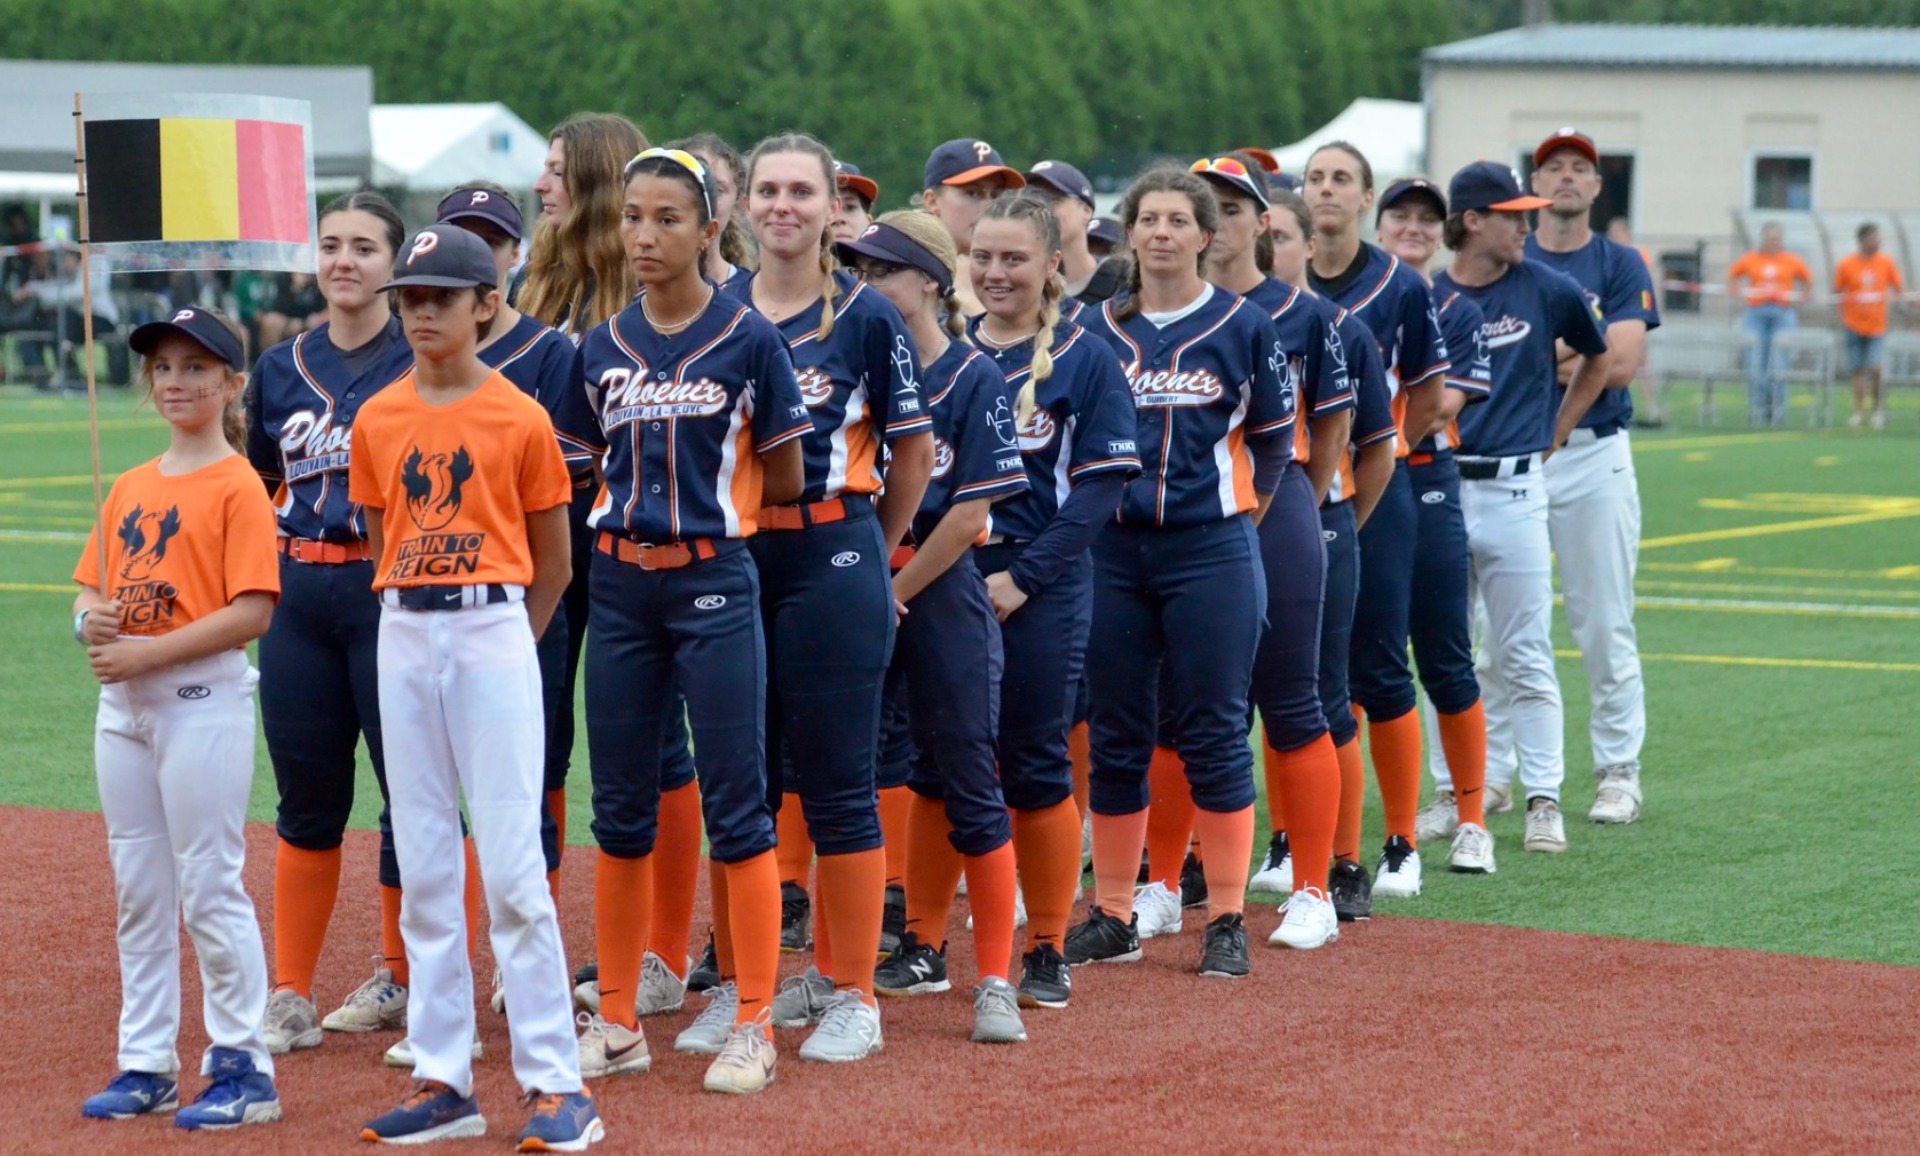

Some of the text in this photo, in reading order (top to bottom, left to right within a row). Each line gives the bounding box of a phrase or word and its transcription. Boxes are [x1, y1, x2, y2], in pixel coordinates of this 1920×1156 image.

[972, 141, 992, 162] P
[470, 190, 490, 206] P
[861, 224, 879, 239] P
[407, 231, 439, 268] P
[171, 309, 195, 323] P
[600, 367, 727, 408] Phoenix
[400, 534, 482, 560] TRAIN TO
[386, 554, 479, 581] REIGN
